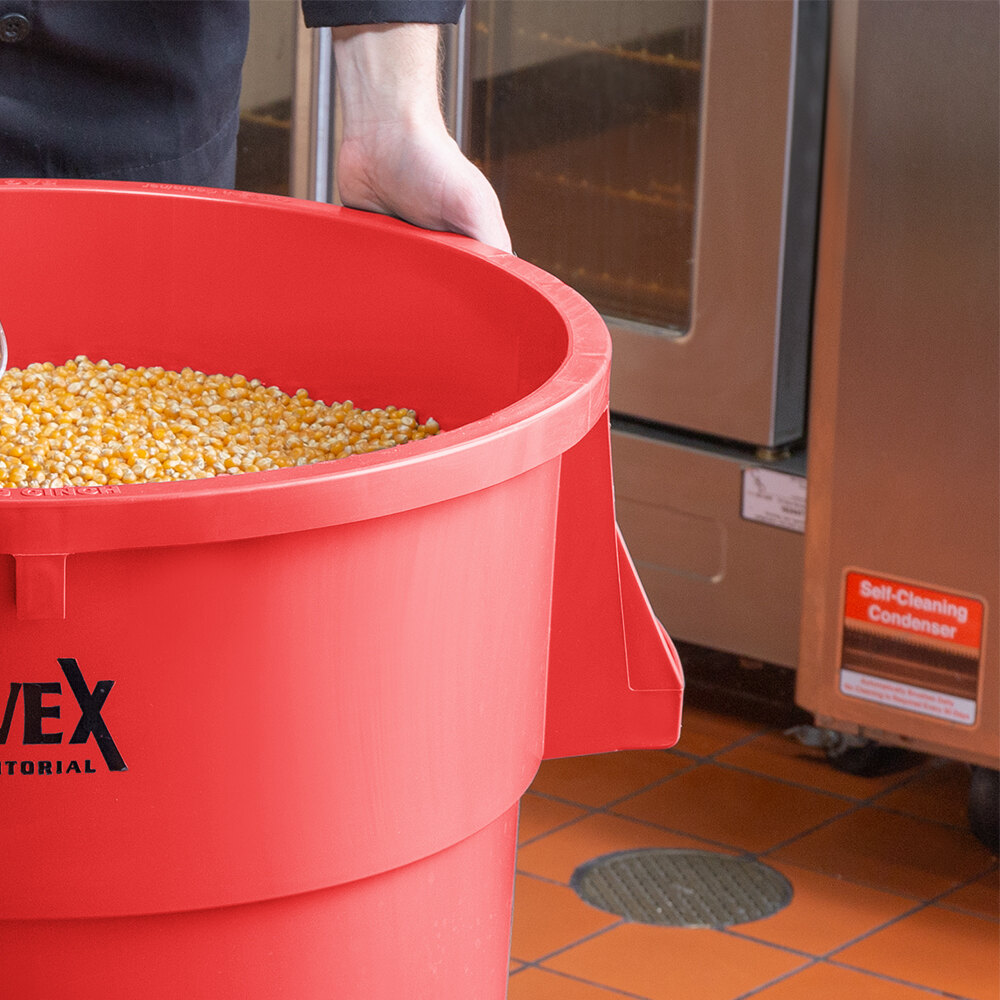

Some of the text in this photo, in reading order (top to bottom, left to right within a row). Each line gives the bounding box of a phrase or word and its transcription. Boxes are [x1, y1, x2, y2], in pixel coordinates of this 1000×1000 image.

[20, 485, 122, 497] CINCH
[859, 579, 969, 624] Self-Cleaning
[867, 603, 958, 640] Condenser
